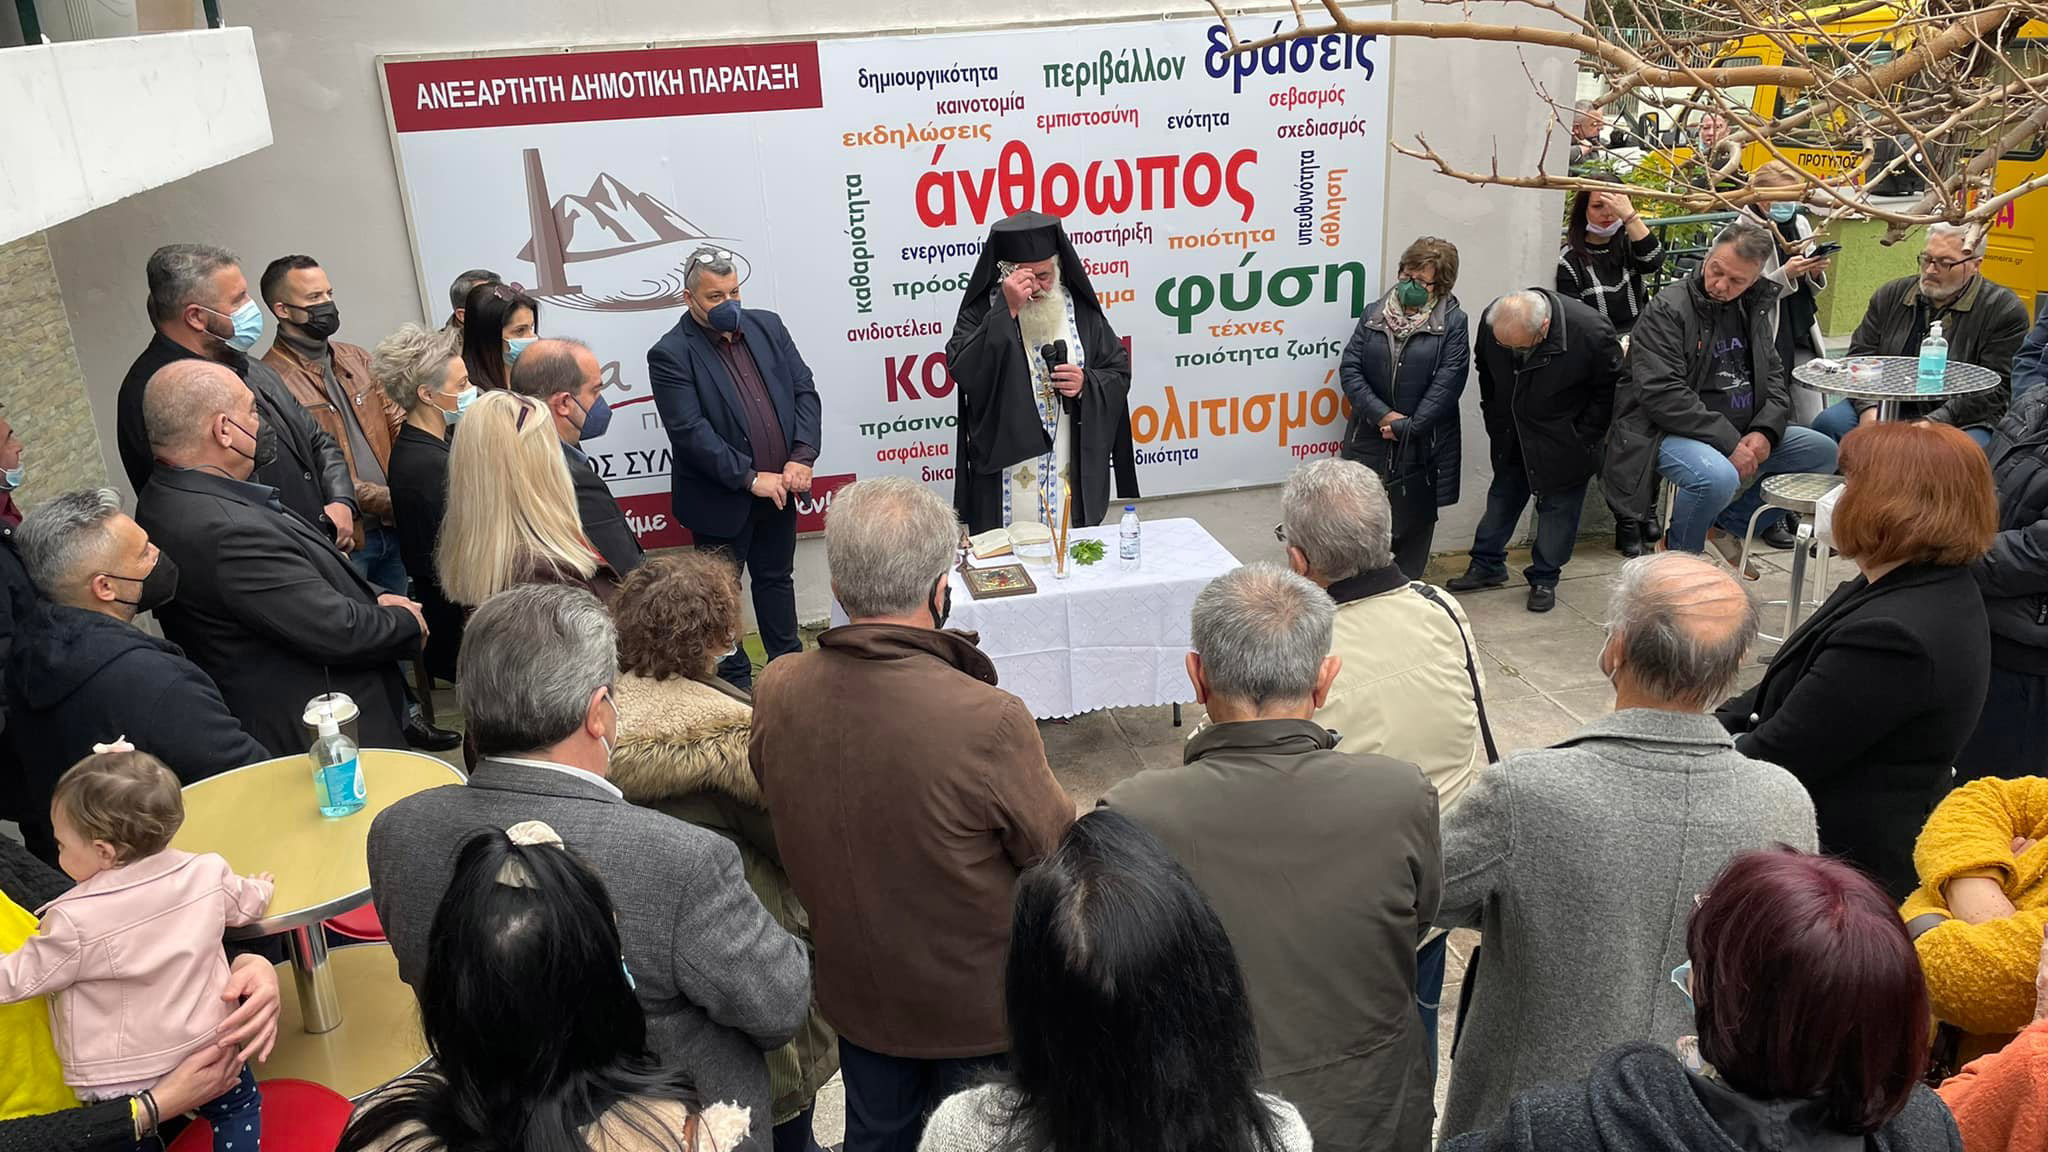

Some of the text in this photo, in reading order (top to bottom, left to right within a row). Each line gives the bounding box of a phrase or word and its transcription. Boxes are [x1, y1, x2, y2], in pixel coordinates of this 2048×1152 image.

[1204, 20, 1377, 94] δράσεις
[417, 63, 800, 110] ΑΝΕΞΑΡΤΗΤΗ ΔΗΜΟΤΙΚΗ ΠΑΡΑΤΑΞΗ
[858, 62, 998, 93] δημιουργικότητα
[1043, 48, 1185, 97] περιβάλλον
[936, 91, 1025, 116] καινοτομία
[1269, 83, 1345, 111] σεβασμός
[1036, 104, 1139, 134] εμπιστοσύνη
[1167, 109, 1230, 132] ενότητα
[1277, 114, 1366, 140] σχεδιασμός
[842, 121, 992, 149] εκδηλώσεις
[915, 139, 1258, 228] άνθρωπος
[1293, 150, 1320, 246] υπευθυνότητα
[1320, 168, 1349, 247] άθληση
[844, 174, 874, 313] καθαριότητα
[901, 236, 984, 264] ενεργοποί
[1168, 228, 1275, 250] ποιότητα
[893, 272, 971, 300] πρόοδ
[1155, 251, 1366, 334] φύση
[847, 319, 942, 342] ανιδιοτέλεια
[1208, 319, 1285, 337] τέχνες
[1175, 336, 1341, 367] ποιότητα ζωής
[1131, 369, 1353, 447] ολιτισμό
[876, 441, 949, 464] ασφάλεια
[1135, 446, 1198, 466] δικότητα
